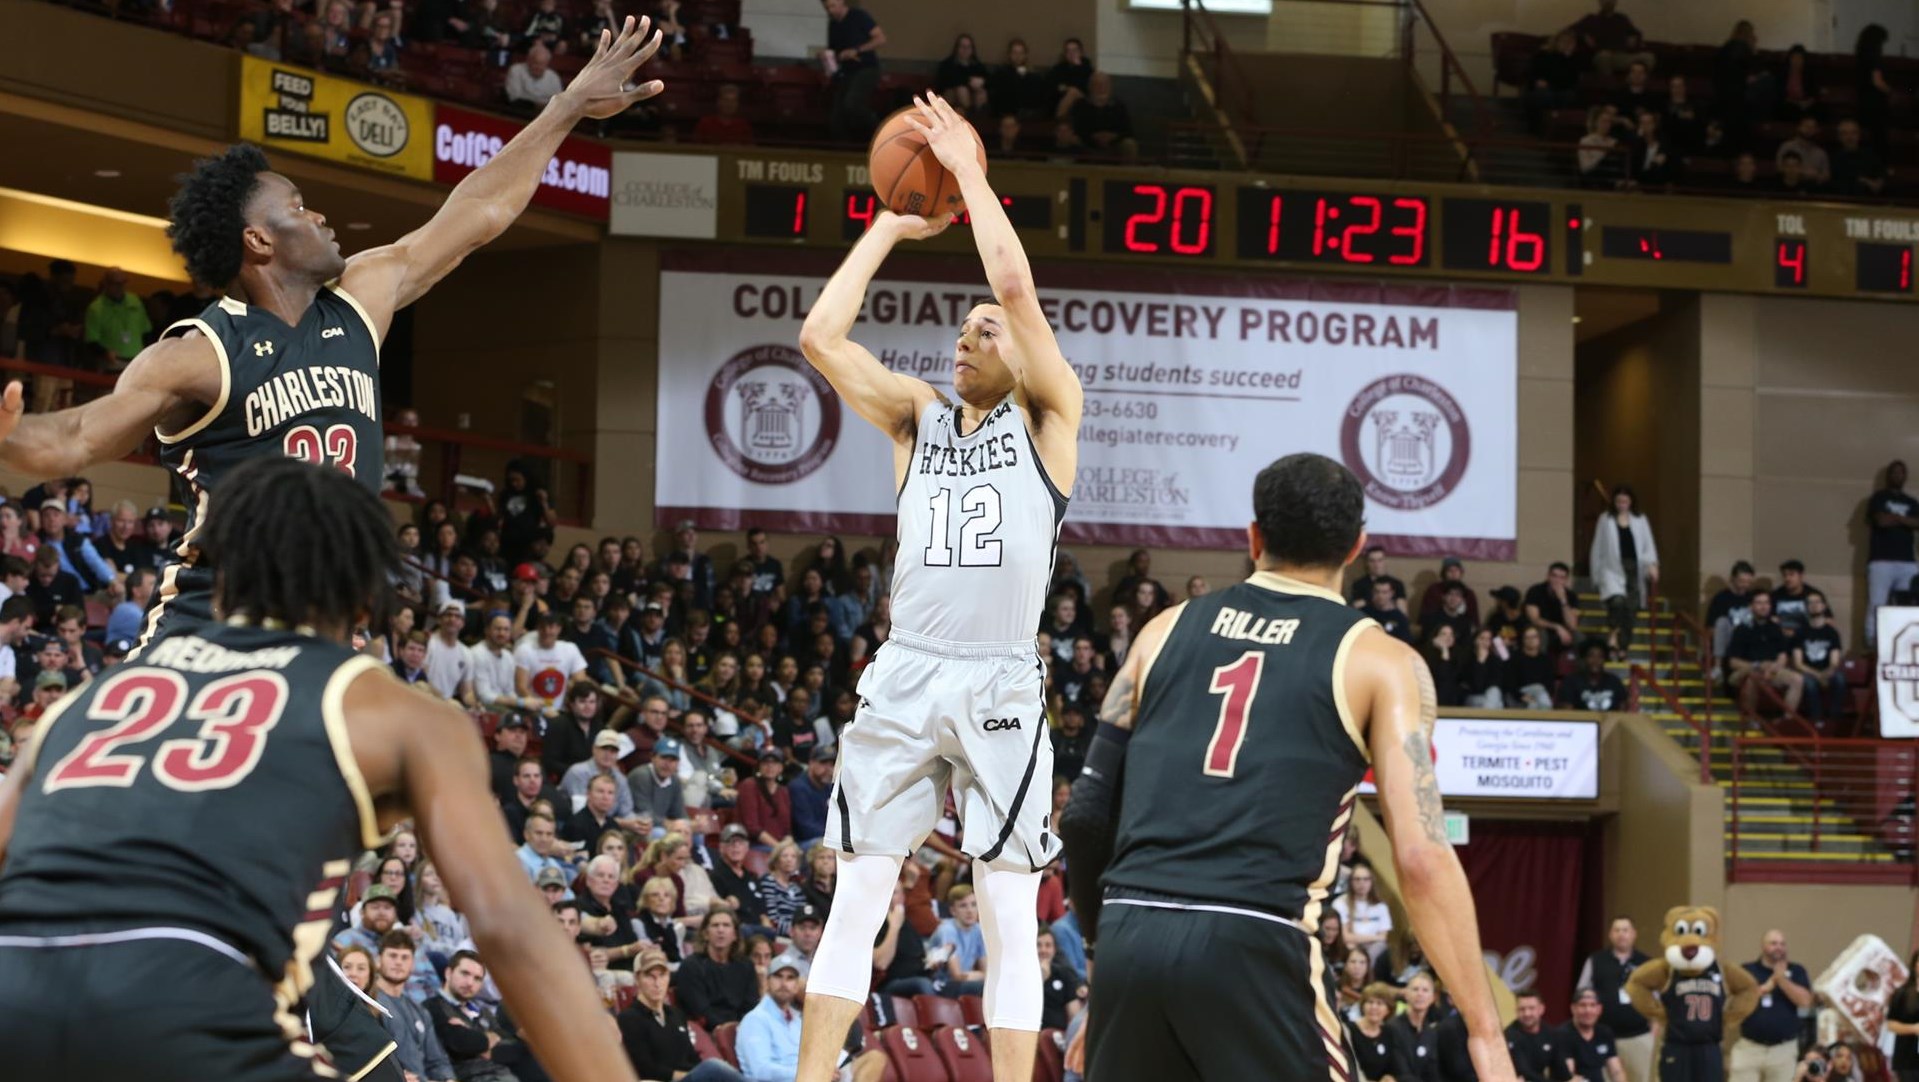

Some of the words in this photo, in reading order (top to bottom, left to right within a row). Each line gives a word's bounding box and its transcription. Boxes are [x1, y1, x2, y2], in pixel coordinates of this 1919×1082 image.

[273, 73, 312, 96] FEED
[267, 113, 327, 138] BELLY!
[351, 101, 378, 122] EAST
[359, 119, 394, 147] DELI
[436, 124, 609, 198] CofCSs.com
[737, 160, 766, 180] TM
[769, 162, 823, 183] FOULS
[792, 192, 805, 233] 1
[848, 194, 875, 231] 4
[1124, 185, 1213, 255] 20
[1268, 196, 1426, 265] 11:23
[1777, 214, 1806, 235] TOL
[1845, 218, 1870, 238] TM
[1489, 207, 1544, 271] 16
[1778, 243, 1804, 284] 4
[1899, 249, 1911, 289] 1
[322, 326, 345, 339] CAA
[733, 284, 992, 327] COLGIAT
[1037, 298, 1227, 341] ECOVERY
[1239, 309, 1441, 351] PROGRAM
[881, 349, 955, 376] Helpin
[1104, 362, 1203, 384] students
[1209, 369, 1303, 389] succeed
[245, 365, 377, 437] CHARLESTON
[919, 432, 1018, 477] HUSKIES
[1078, 466, 1160, 486] OLLEGE
[924, 483, 1003, 568] 12
[1210, 606, 1301, 645] RILLER
[42, 666, 290, 795] 23
[983, 717, 1022, 732] CAA
[1202, 650, 1266, 779] 1
[1462, 756, 1521, 770] TERMITE
[1535, 757, 1569, 771] PEST
[1476, 775, 1554, 790] MOSQUITO
[1684, 994, 1713, 1022] 70
